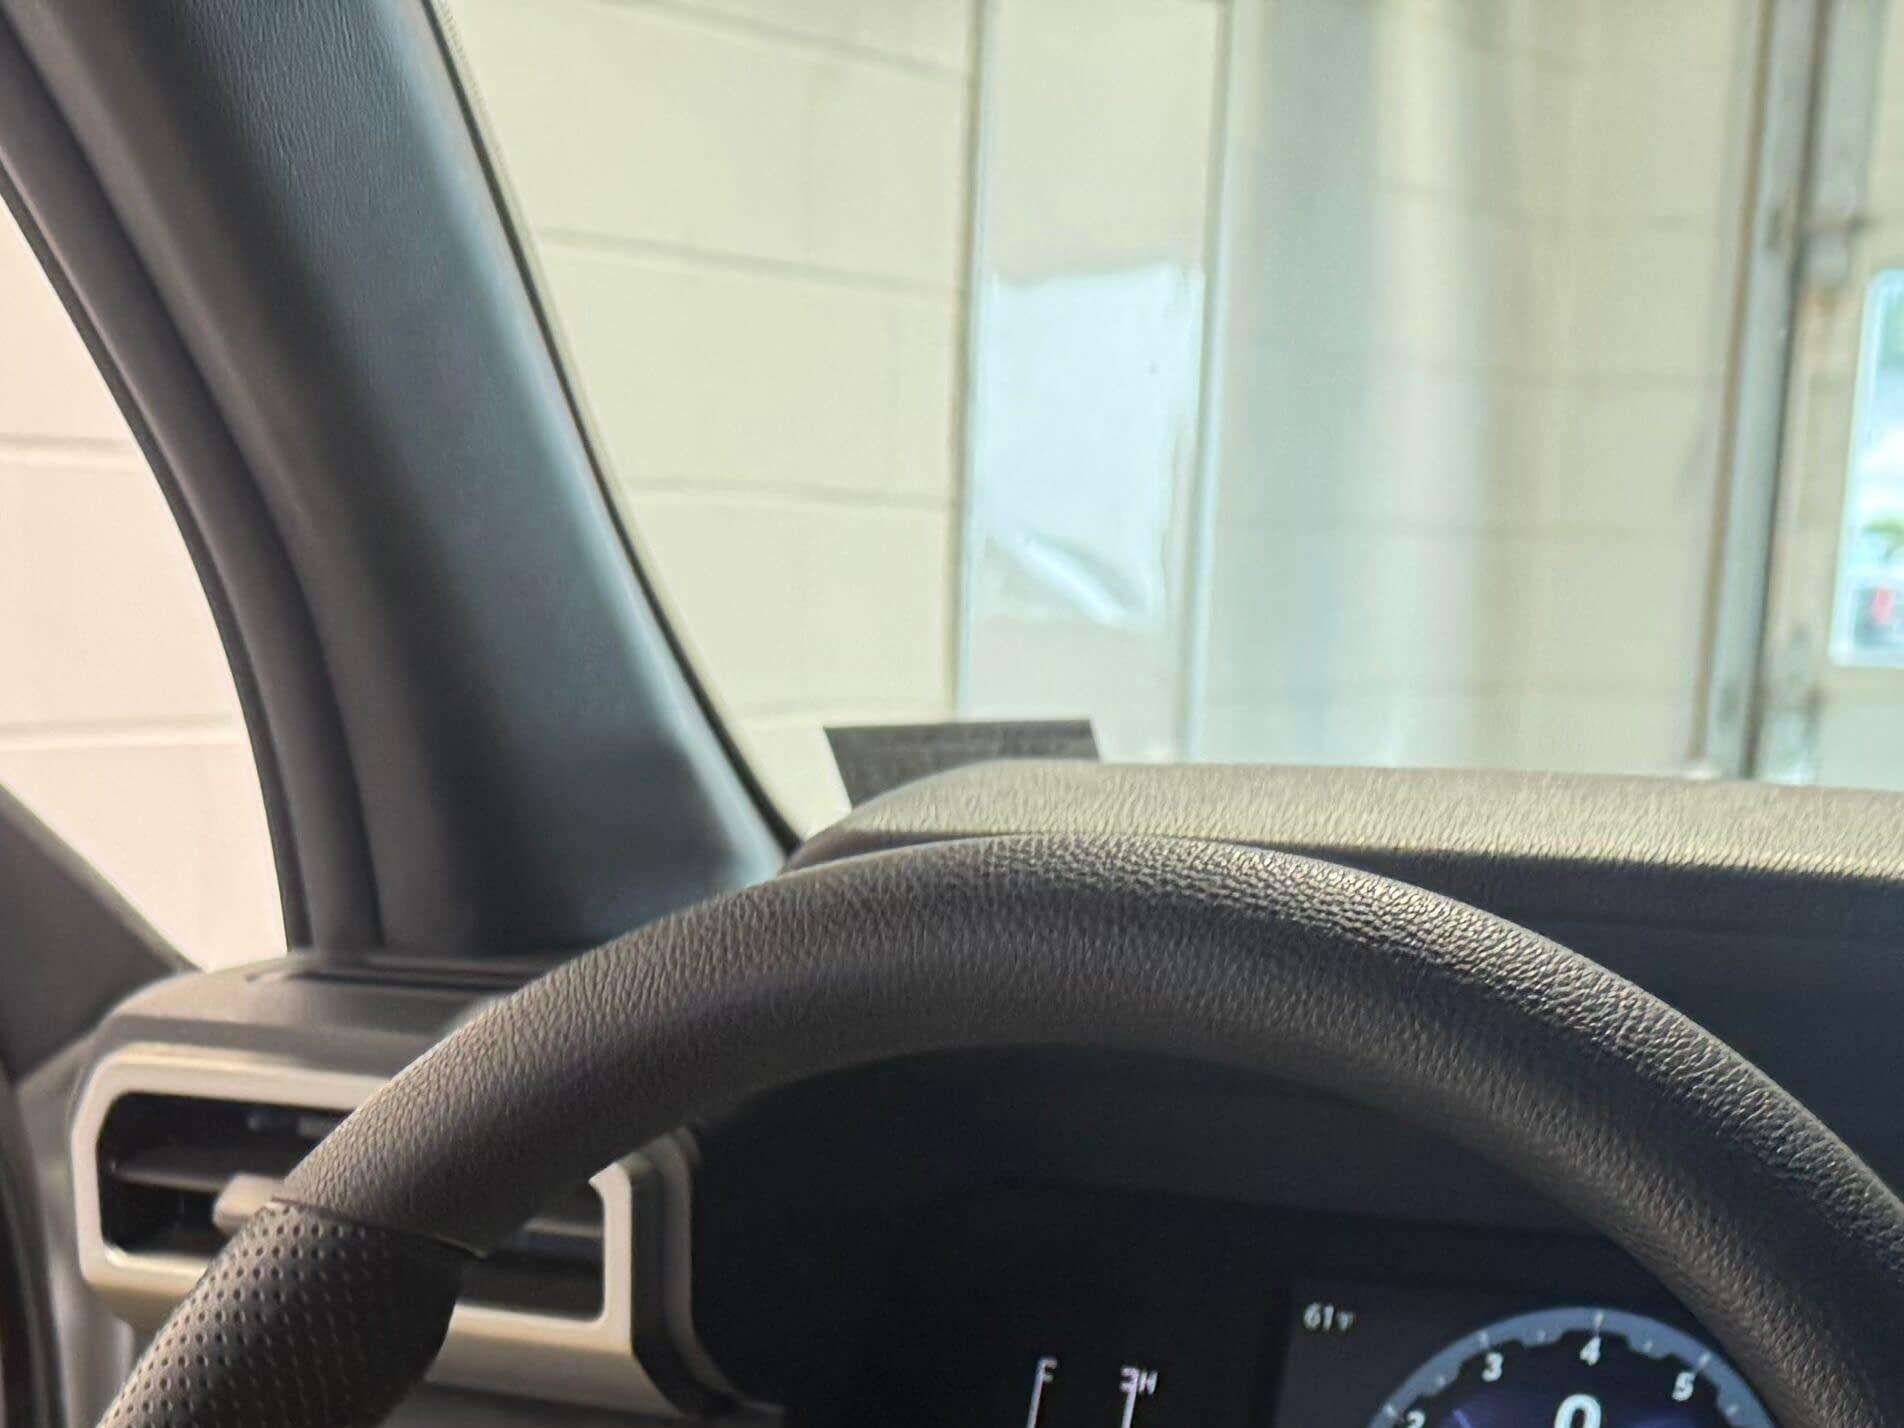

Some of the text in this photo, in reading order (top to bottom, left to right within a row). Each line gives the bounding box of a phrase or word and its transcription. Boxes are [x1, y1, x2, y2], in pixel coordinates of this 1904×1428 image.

[1580, 1338, 1600, 1365] 4
[1482, 1353, 1503, 1382] 3
[1672, 1373, 1694, 1401] 5
